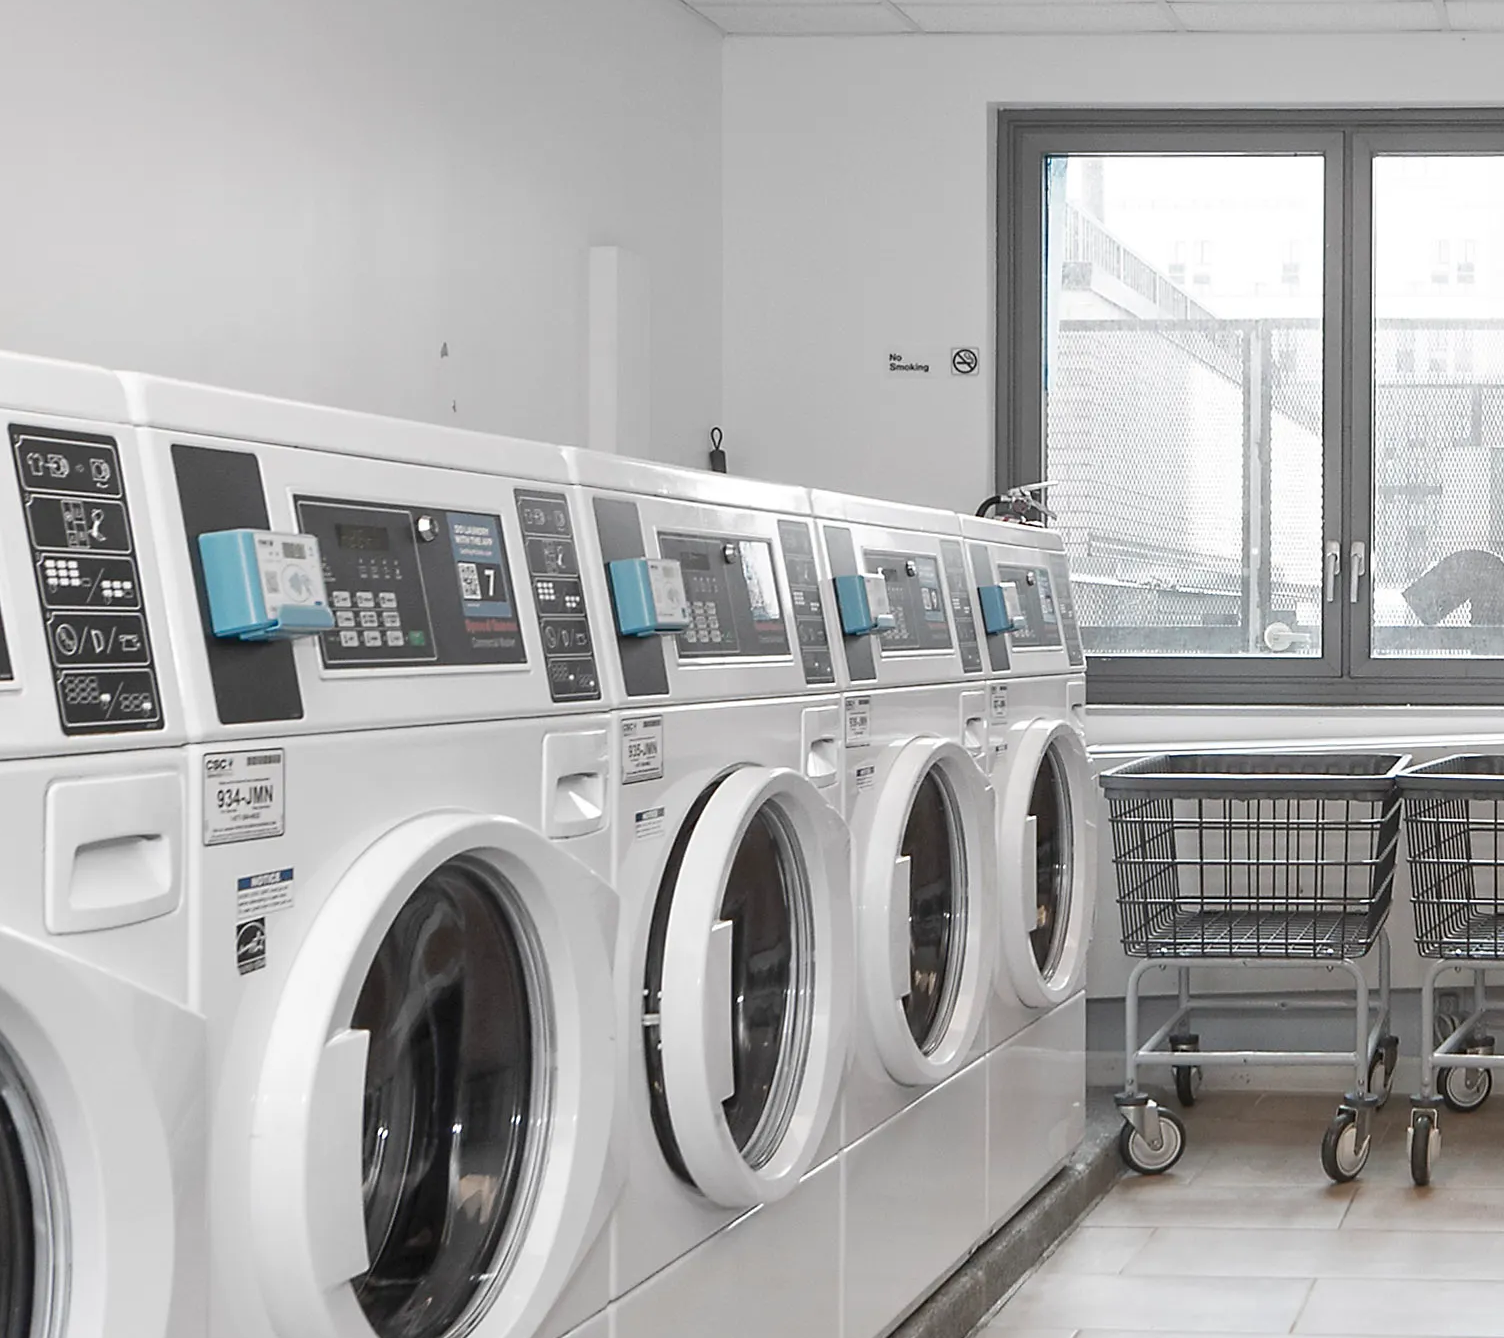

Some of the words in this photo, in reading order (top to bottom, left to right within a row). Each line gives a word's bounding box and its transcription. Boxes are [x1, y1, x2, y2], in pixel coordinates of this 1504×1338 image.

[889, 353, 902, 362] No
[889, 363, 929, 373] Smoking
[484, 569, 495, 597] 7
[205, 759, 227, 771] CSC
[217, 785, 273, 808] 934-JMN
[251, 872, 280, 887] NOTICE
